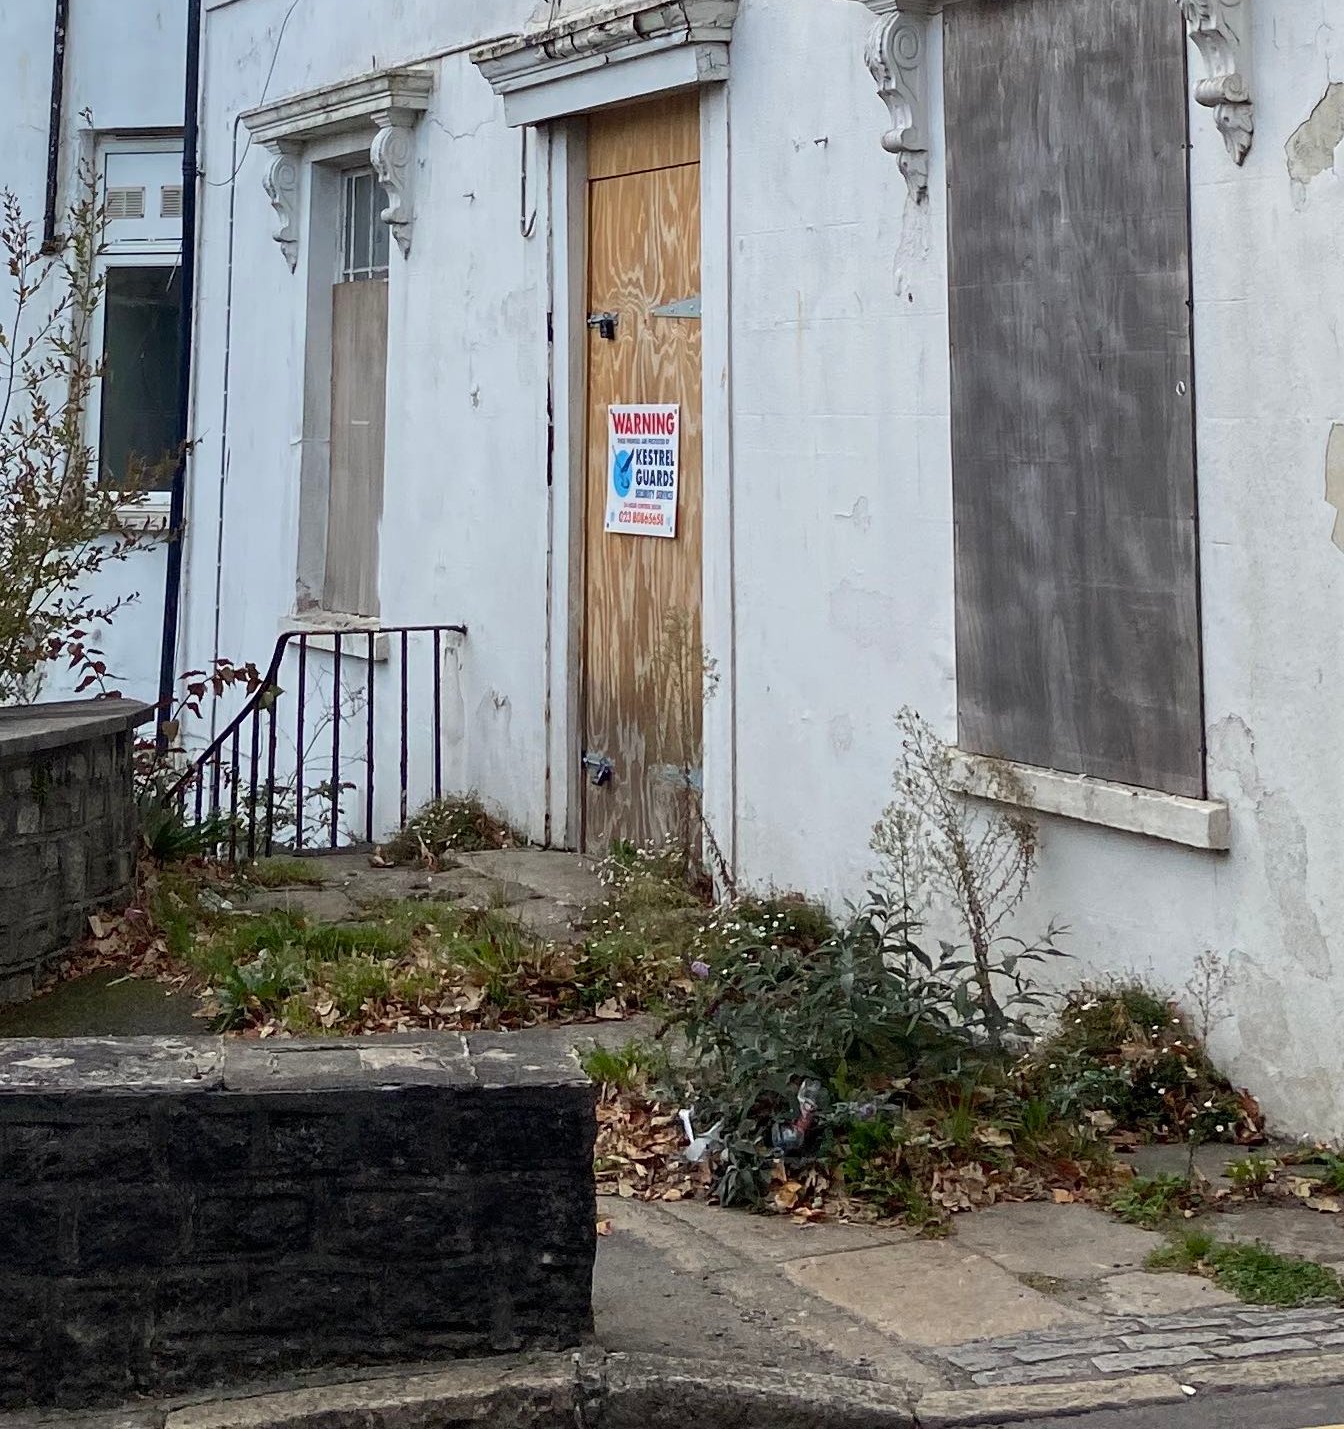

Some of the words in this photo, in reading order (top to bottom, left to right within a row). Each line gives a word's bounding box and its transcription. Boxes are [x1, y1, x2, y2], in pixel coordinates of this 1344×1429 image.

[613, 413, 675, 435] WARNING
[636, 448, 675, 467] KESTREL
[636, 469, 674, 487] GUARDS
[618, 510, 632, 523] 023
